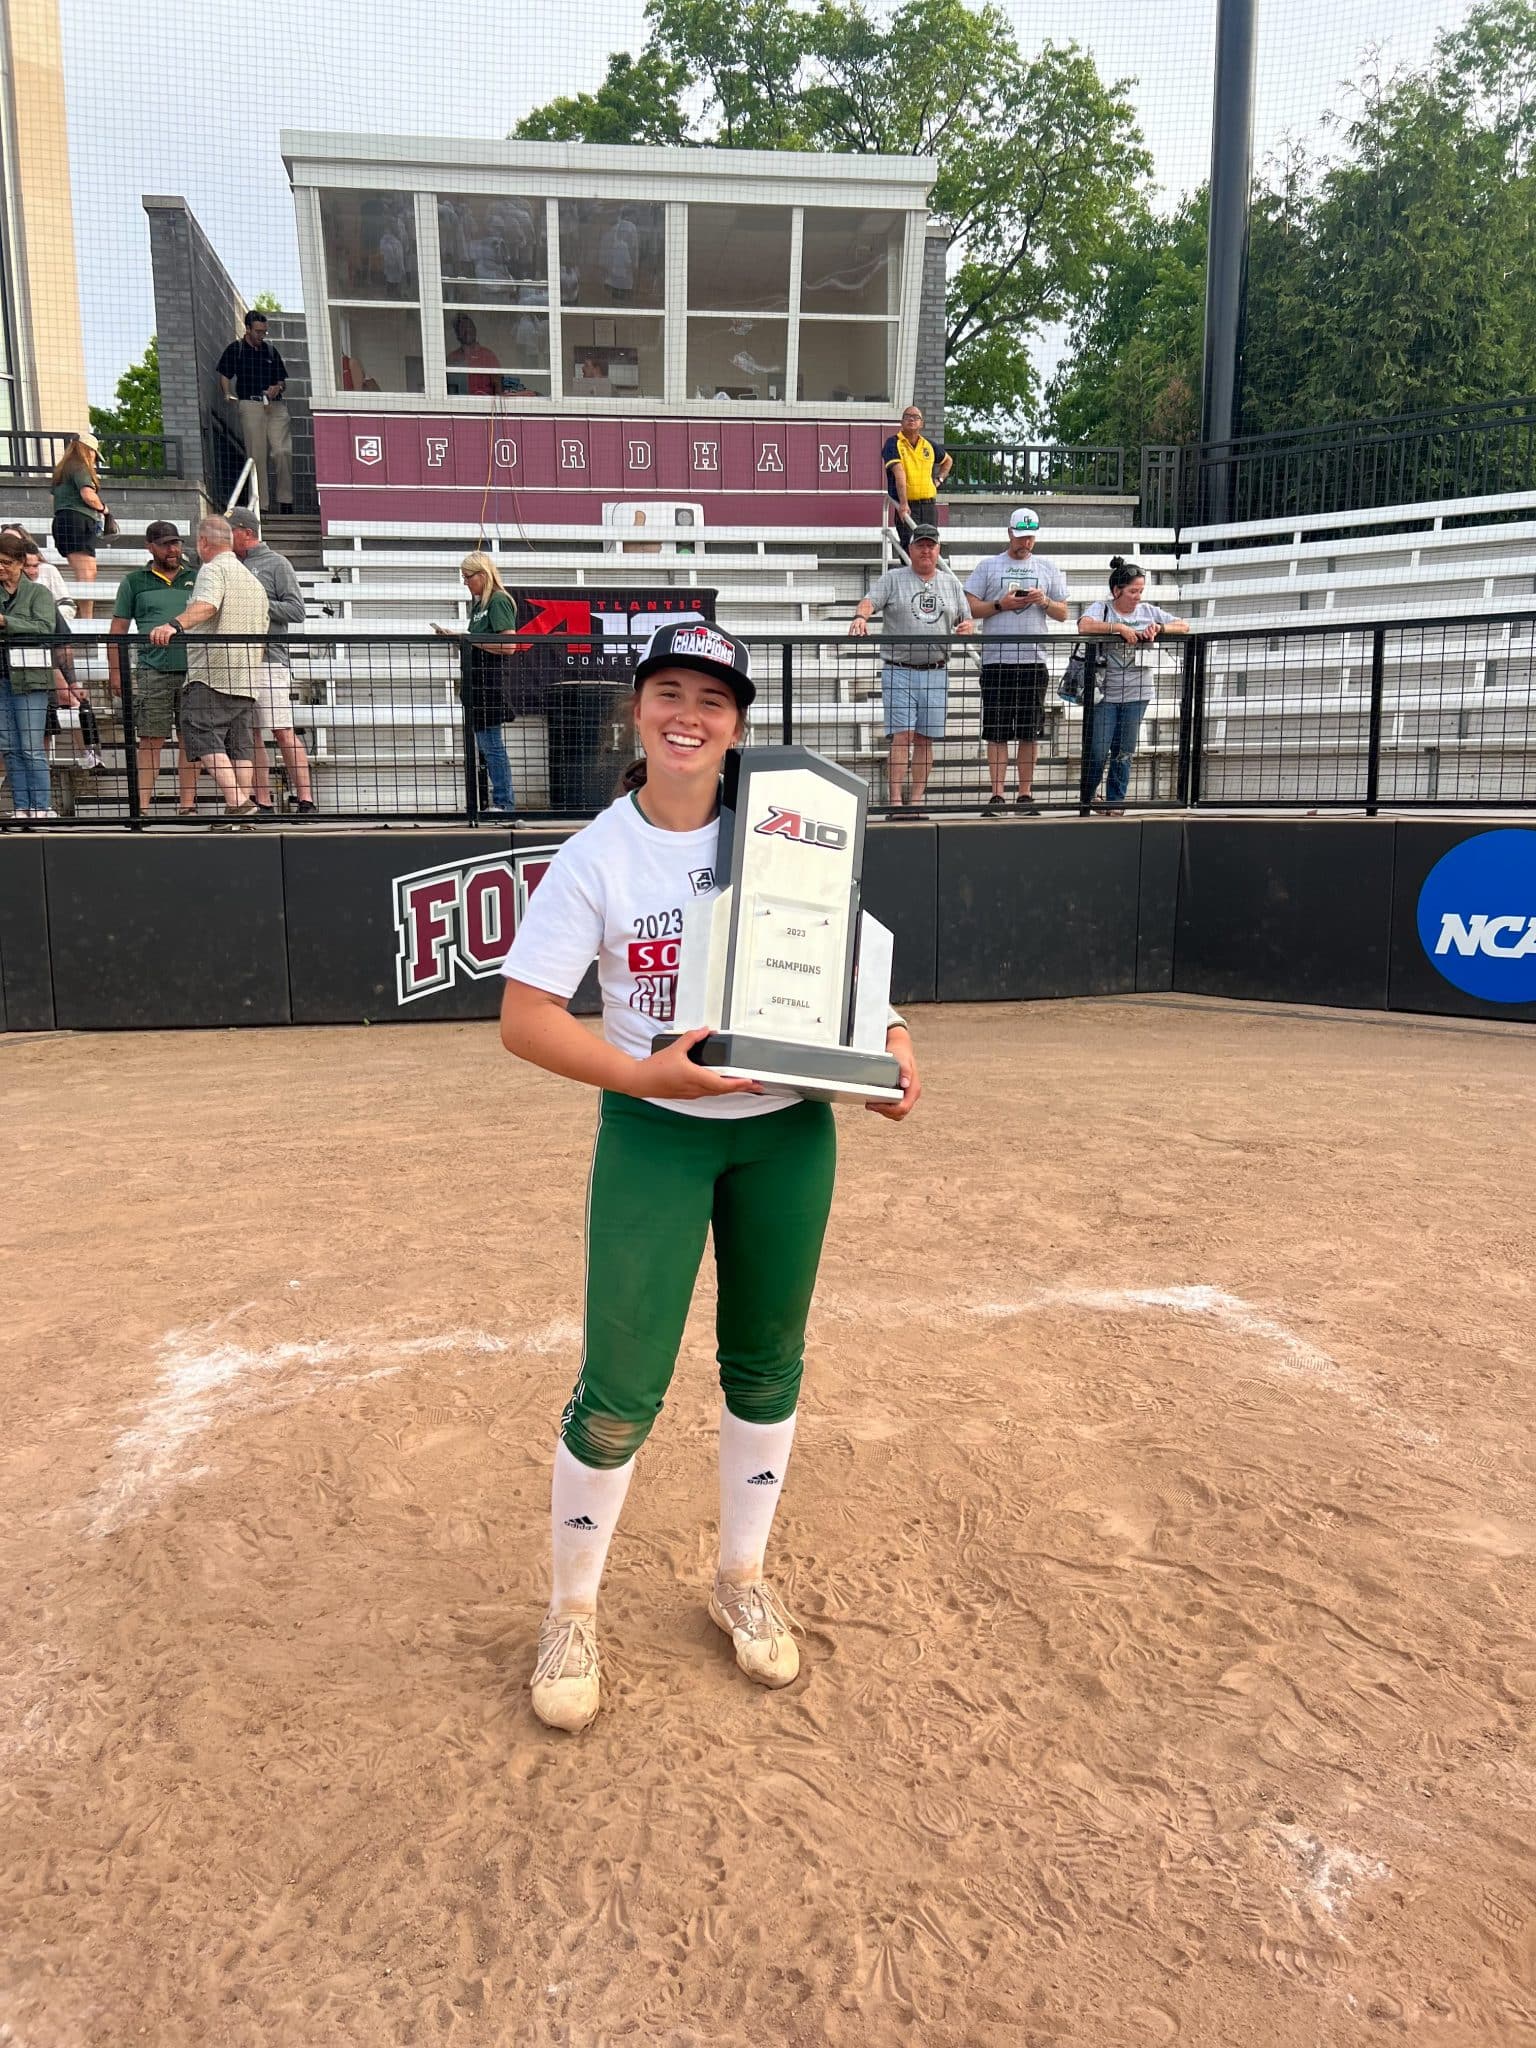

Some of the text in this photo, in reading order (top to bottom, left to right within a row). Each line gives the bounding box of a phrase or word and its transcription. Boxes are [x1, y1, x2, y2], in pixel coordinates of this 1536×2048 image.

[673, 632, 733, 661] CHAMPIONS
[753, 805, 849, 850] A10
[633, 908, 683, 940] 2023
[786, 927, 806, 938] 2023
[766, 957, 821, 975] CHAMPIONS
[771, 996, 811, 1009] SOFTBALL
